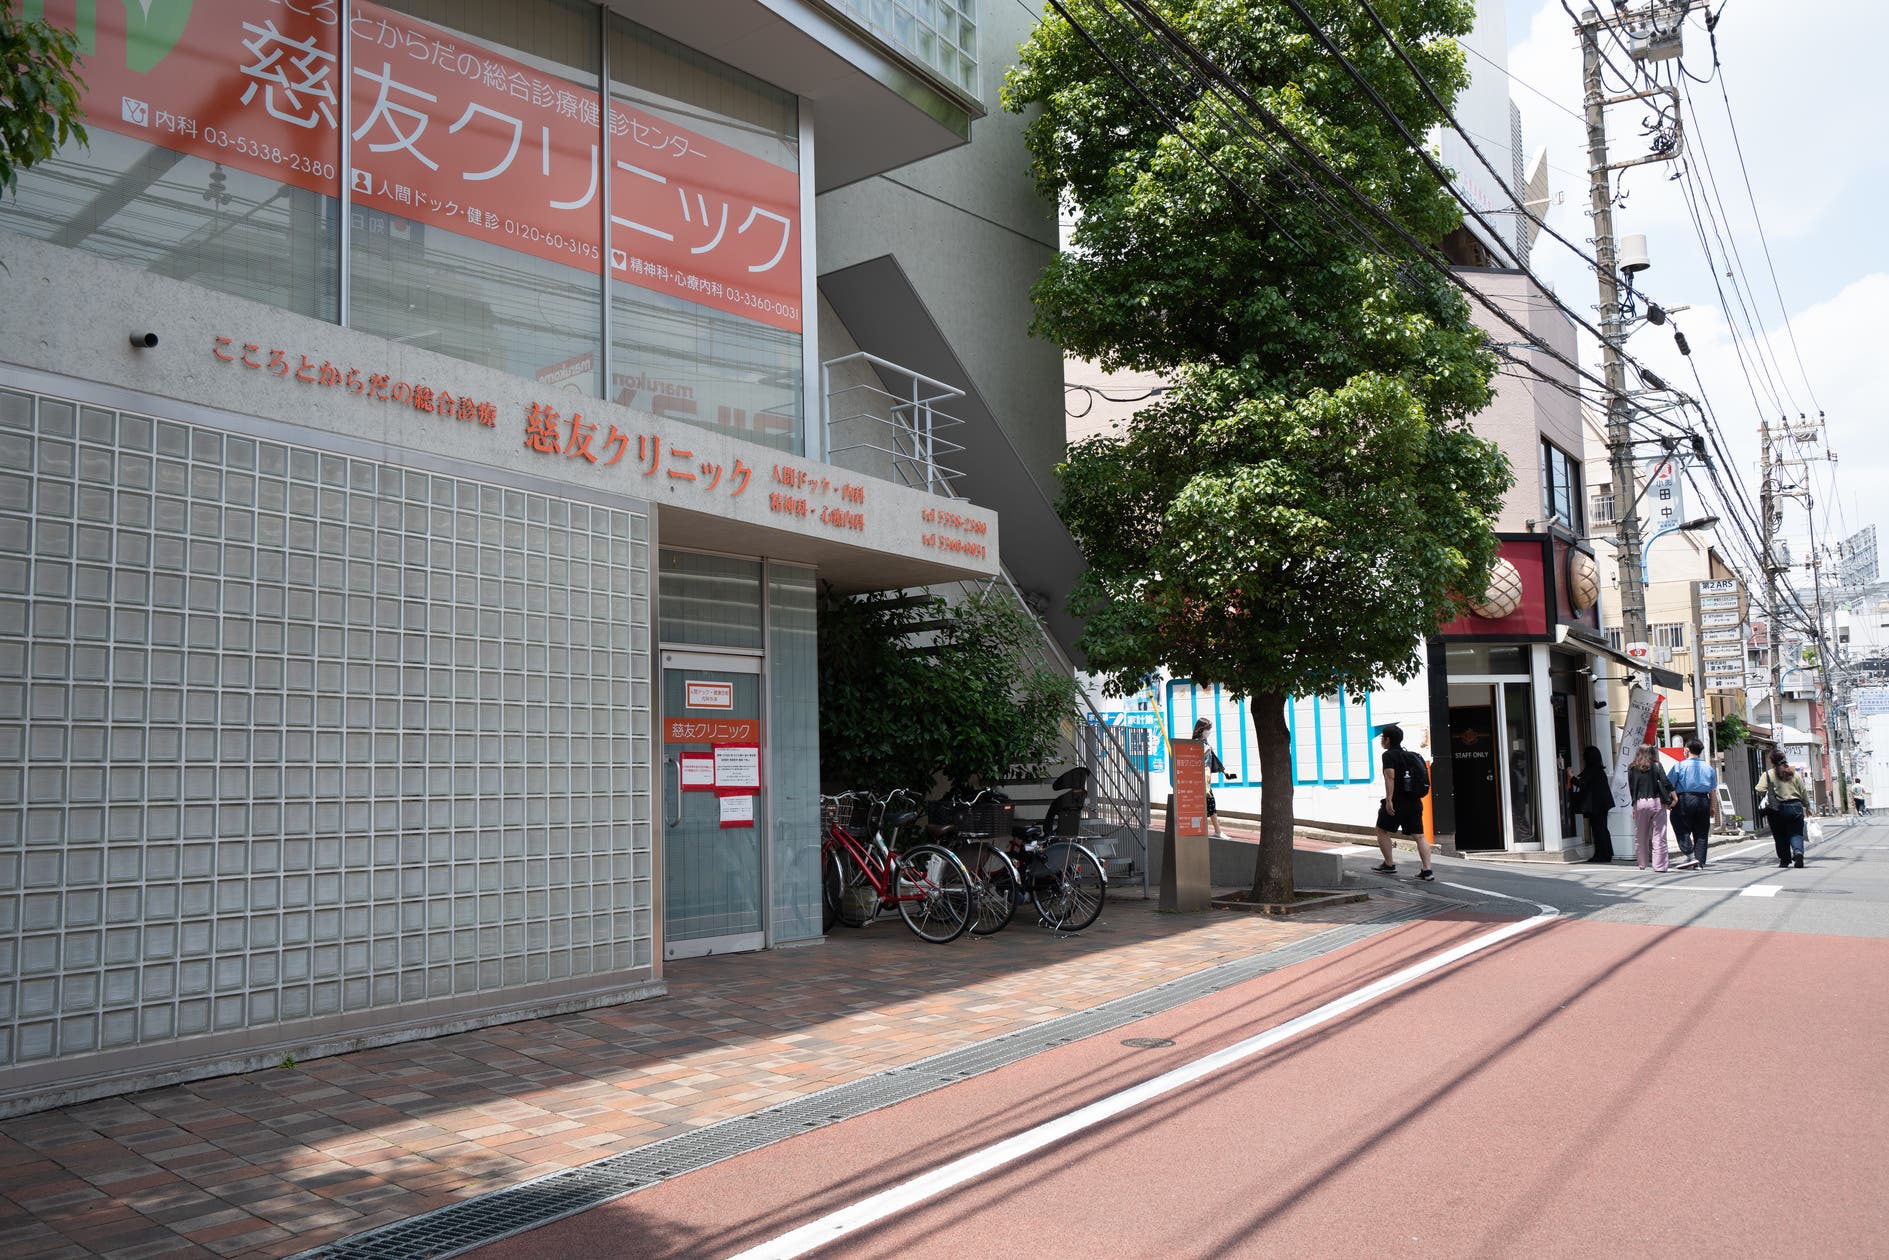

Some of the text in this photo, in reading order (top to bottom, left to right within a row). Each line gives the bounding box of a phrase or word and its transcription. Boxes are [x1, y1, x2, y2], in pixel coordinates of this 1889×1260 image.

[268, 0, 708, 161] ころとからだの総合診療健診センター
[155, 110, 335, 181] 内科 03-5338-2380
[239, 19, 791, 274] 慈友クリニック
[376, 179, 501, 231] 人間ドック・健診
[505, 218, 600, 260] 0120-60-3195
[630, 256, 800, 321] 精神科・心療内科 03-3360-0031
[213, 335, 498, 428] こころとからだの総合診療
[524, 401, 753, 497] 慈友クリニック
[672, 722, 751, 740] 慈友クリニック
